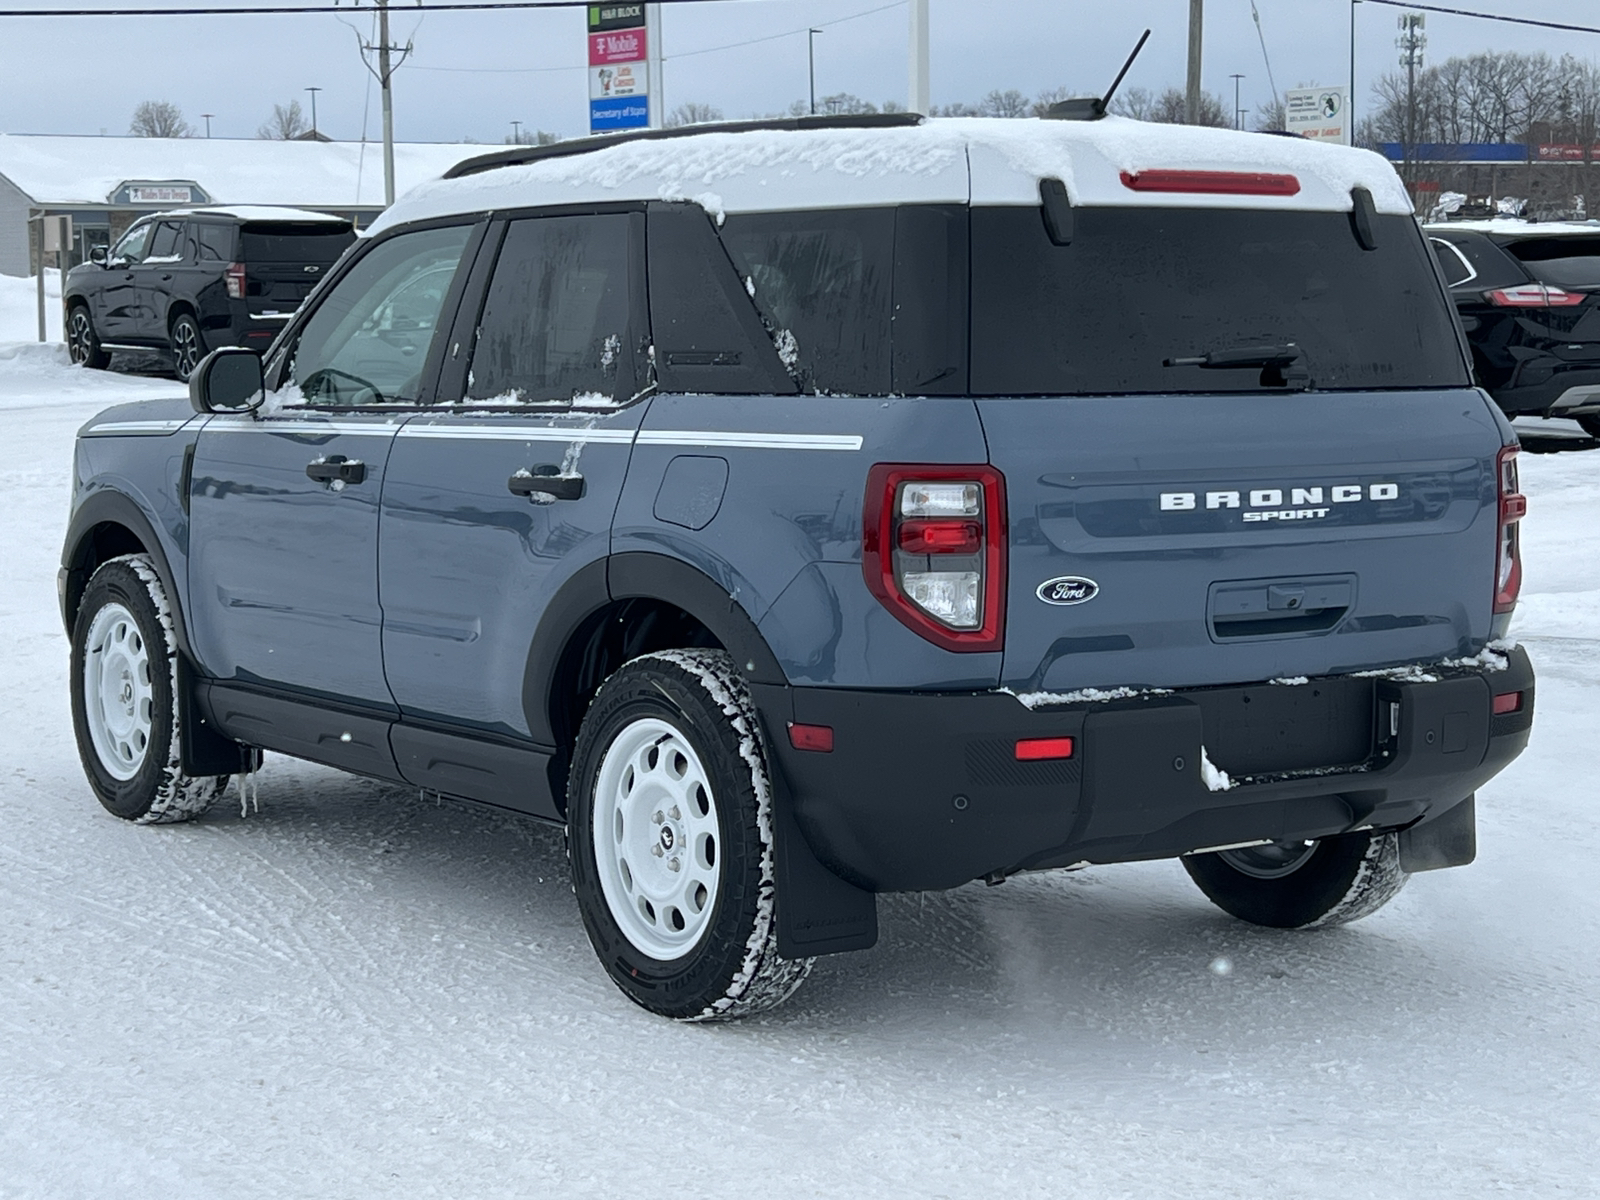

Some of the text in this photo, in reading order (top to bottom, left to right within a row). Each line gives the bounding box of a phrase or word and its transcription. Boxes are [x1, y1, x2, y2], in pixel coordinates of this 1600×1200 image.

[622, 106, 630, 117] of
[1160, 483, 1399, 511] BRONCO
[1242, 508, 1330, 522] SPORT
[1052, 582, 1086, 599] Ford
